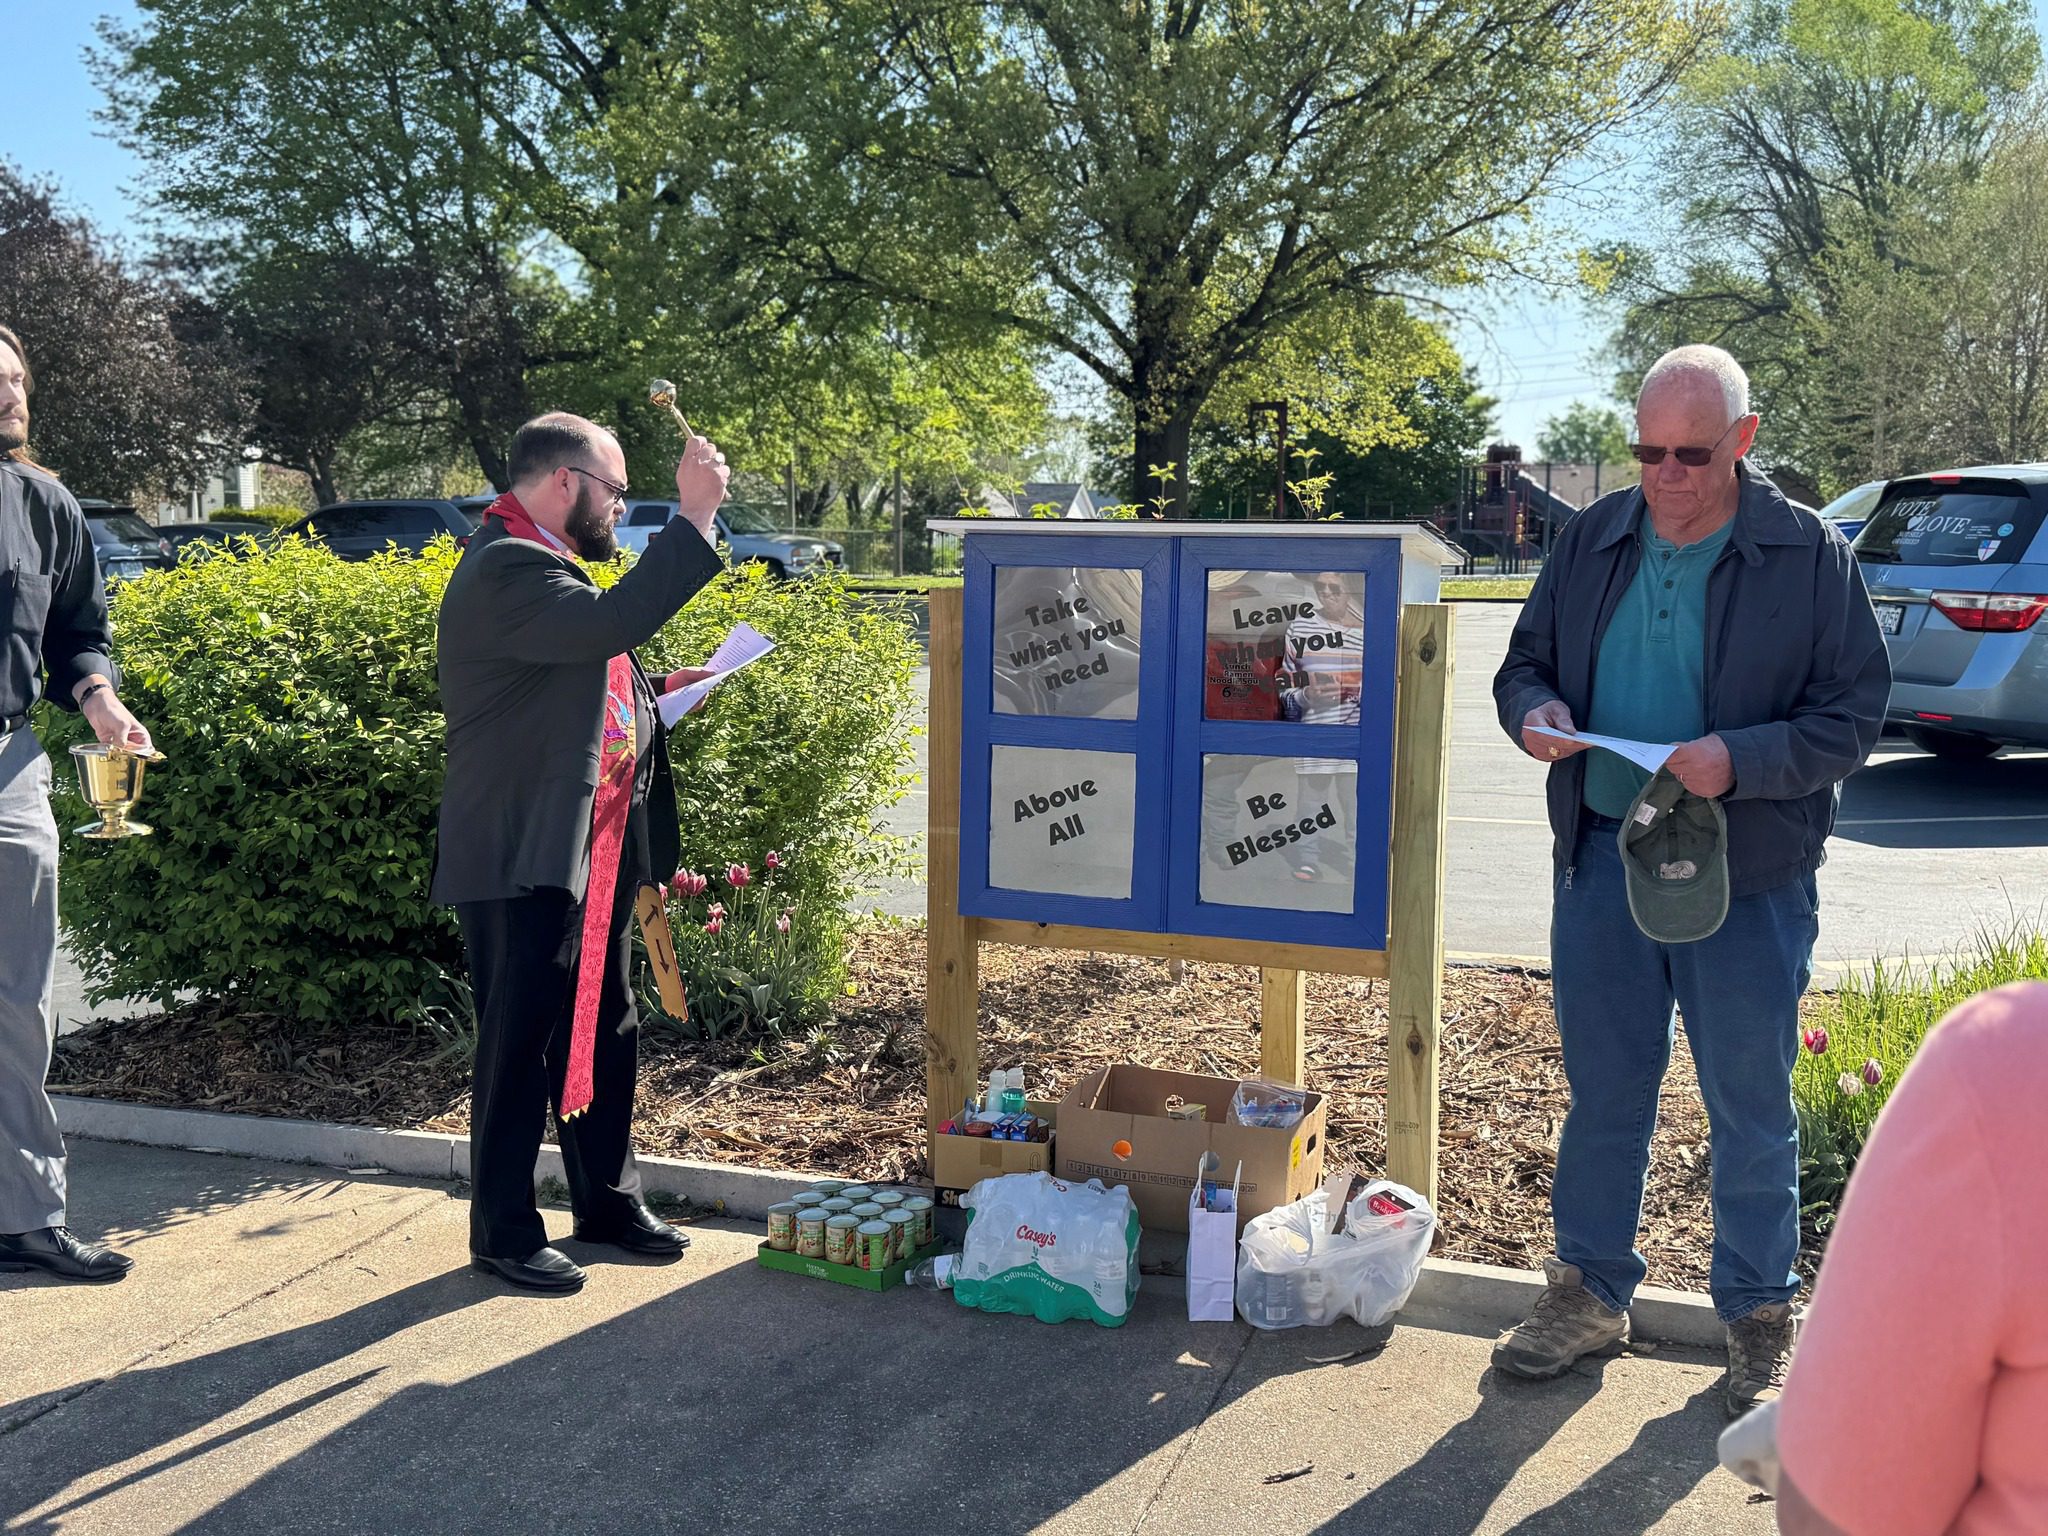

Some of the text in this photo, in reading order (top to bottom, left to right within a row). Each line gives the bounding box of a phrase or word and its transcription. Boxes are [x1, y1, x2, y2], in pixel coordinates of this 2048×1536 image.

[1890, 501, 1936, 518] VOTE
[1914, 515, 1972, 535] LOVE
[1025, 597, 1089, 627] Take
[1233, 602, 1315, 630] Leave
[1009, 618, 1126, 668] what you
[1291, 631, 1344, 658] you
[1045, 653, 1109, 690] need
[1224, 670, 1253, 678] Ramen
[1242, 677, 1263, 685] Sou
[1222, 686, 1231, 698] 6
[1014, 780, 1098, 823] Above
[1246, 793, 1287, 820] Be
[1049, 813, 1085, 846] All
[1225, 803, 1337, 866] Blessed
[1016, 1224, 1057, 1248] Casey's
[1003, 1271, 1065, 1294] DRINKING WATER
